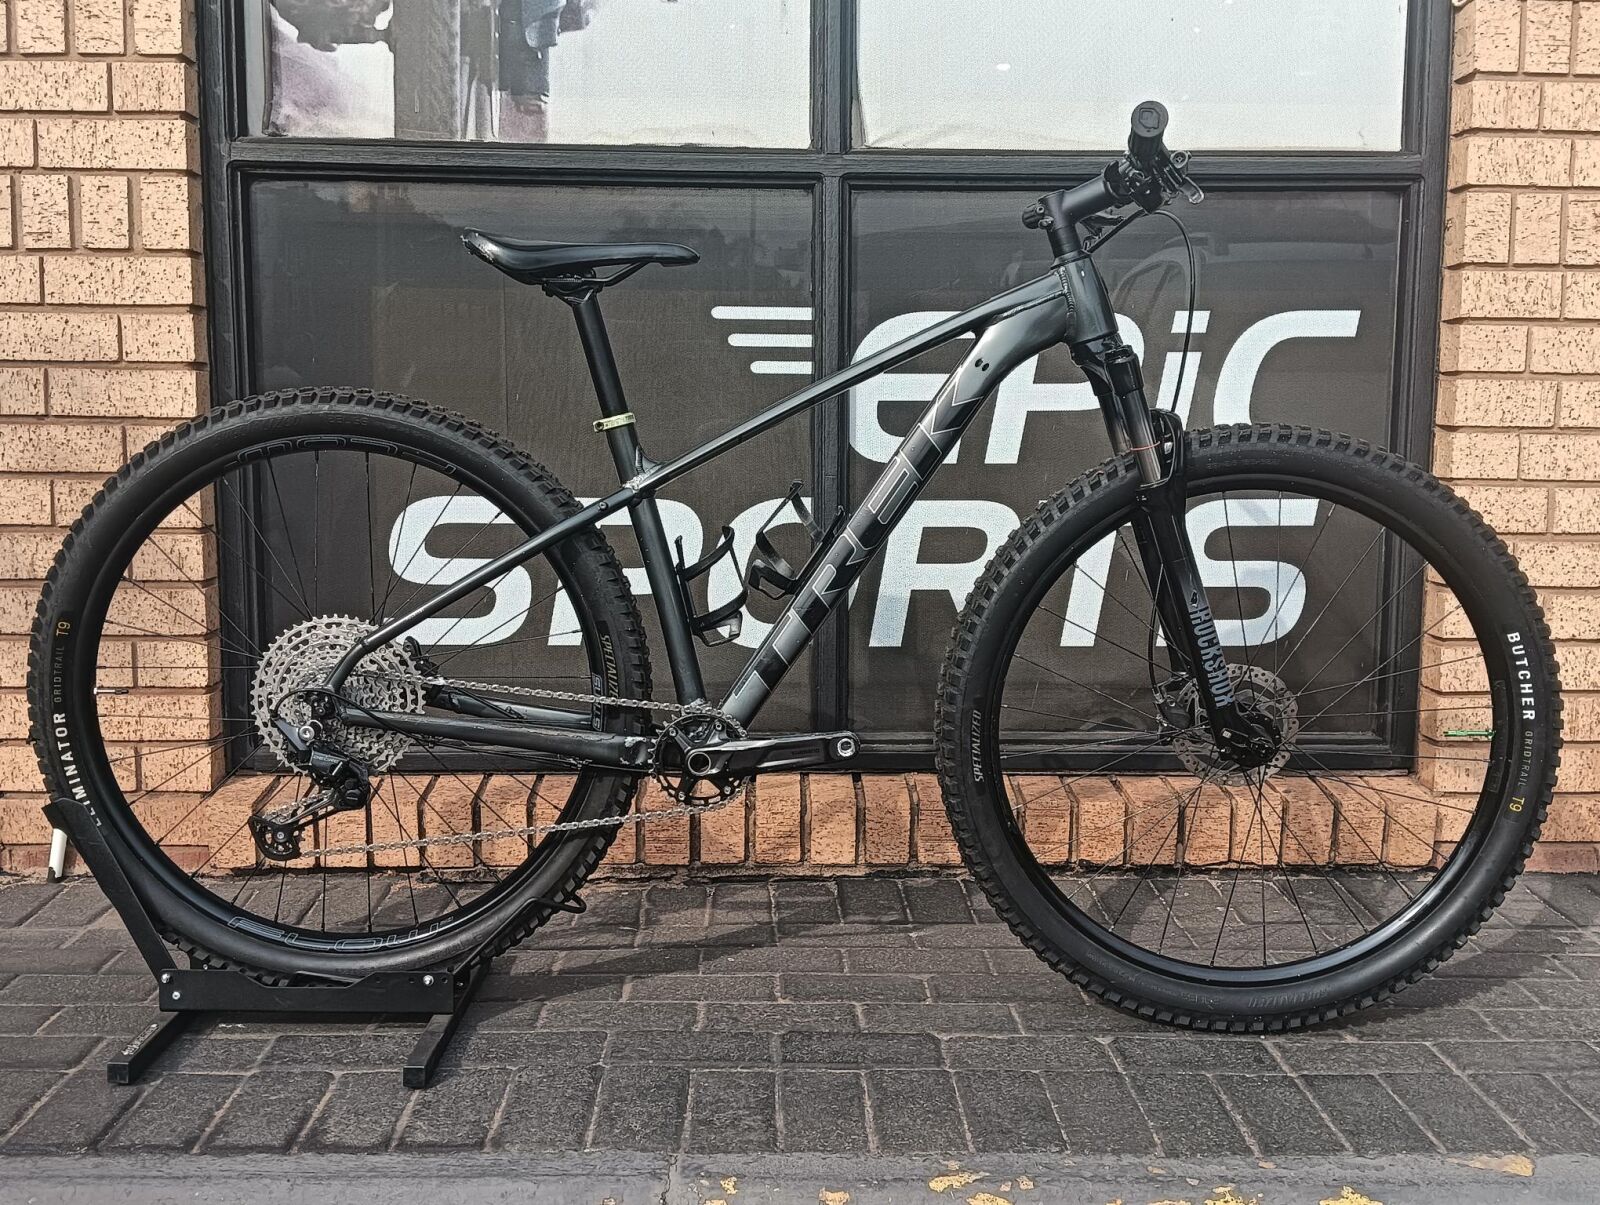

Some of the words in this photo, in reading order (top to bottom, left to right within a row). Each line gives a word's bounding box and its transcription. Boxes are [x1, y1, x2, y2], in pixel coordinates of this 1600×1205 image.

[732, 364, 986, 698] TREK
[56, 621, 71, 637] T9
[1189, 605, 1234, 709] ROCKSHOX
[53, 645, 65, 703] GRIDTRAIL
[600, 634, 619, 703] SPECIALIZE
[1507, 631, 1536, 720] BUTCHER
[971, 709, 985, 783] SPECIALIZED
[1517, 730, 1534, 787] GRIDTRAIL
[1509, 796, 1525, 813] T9
